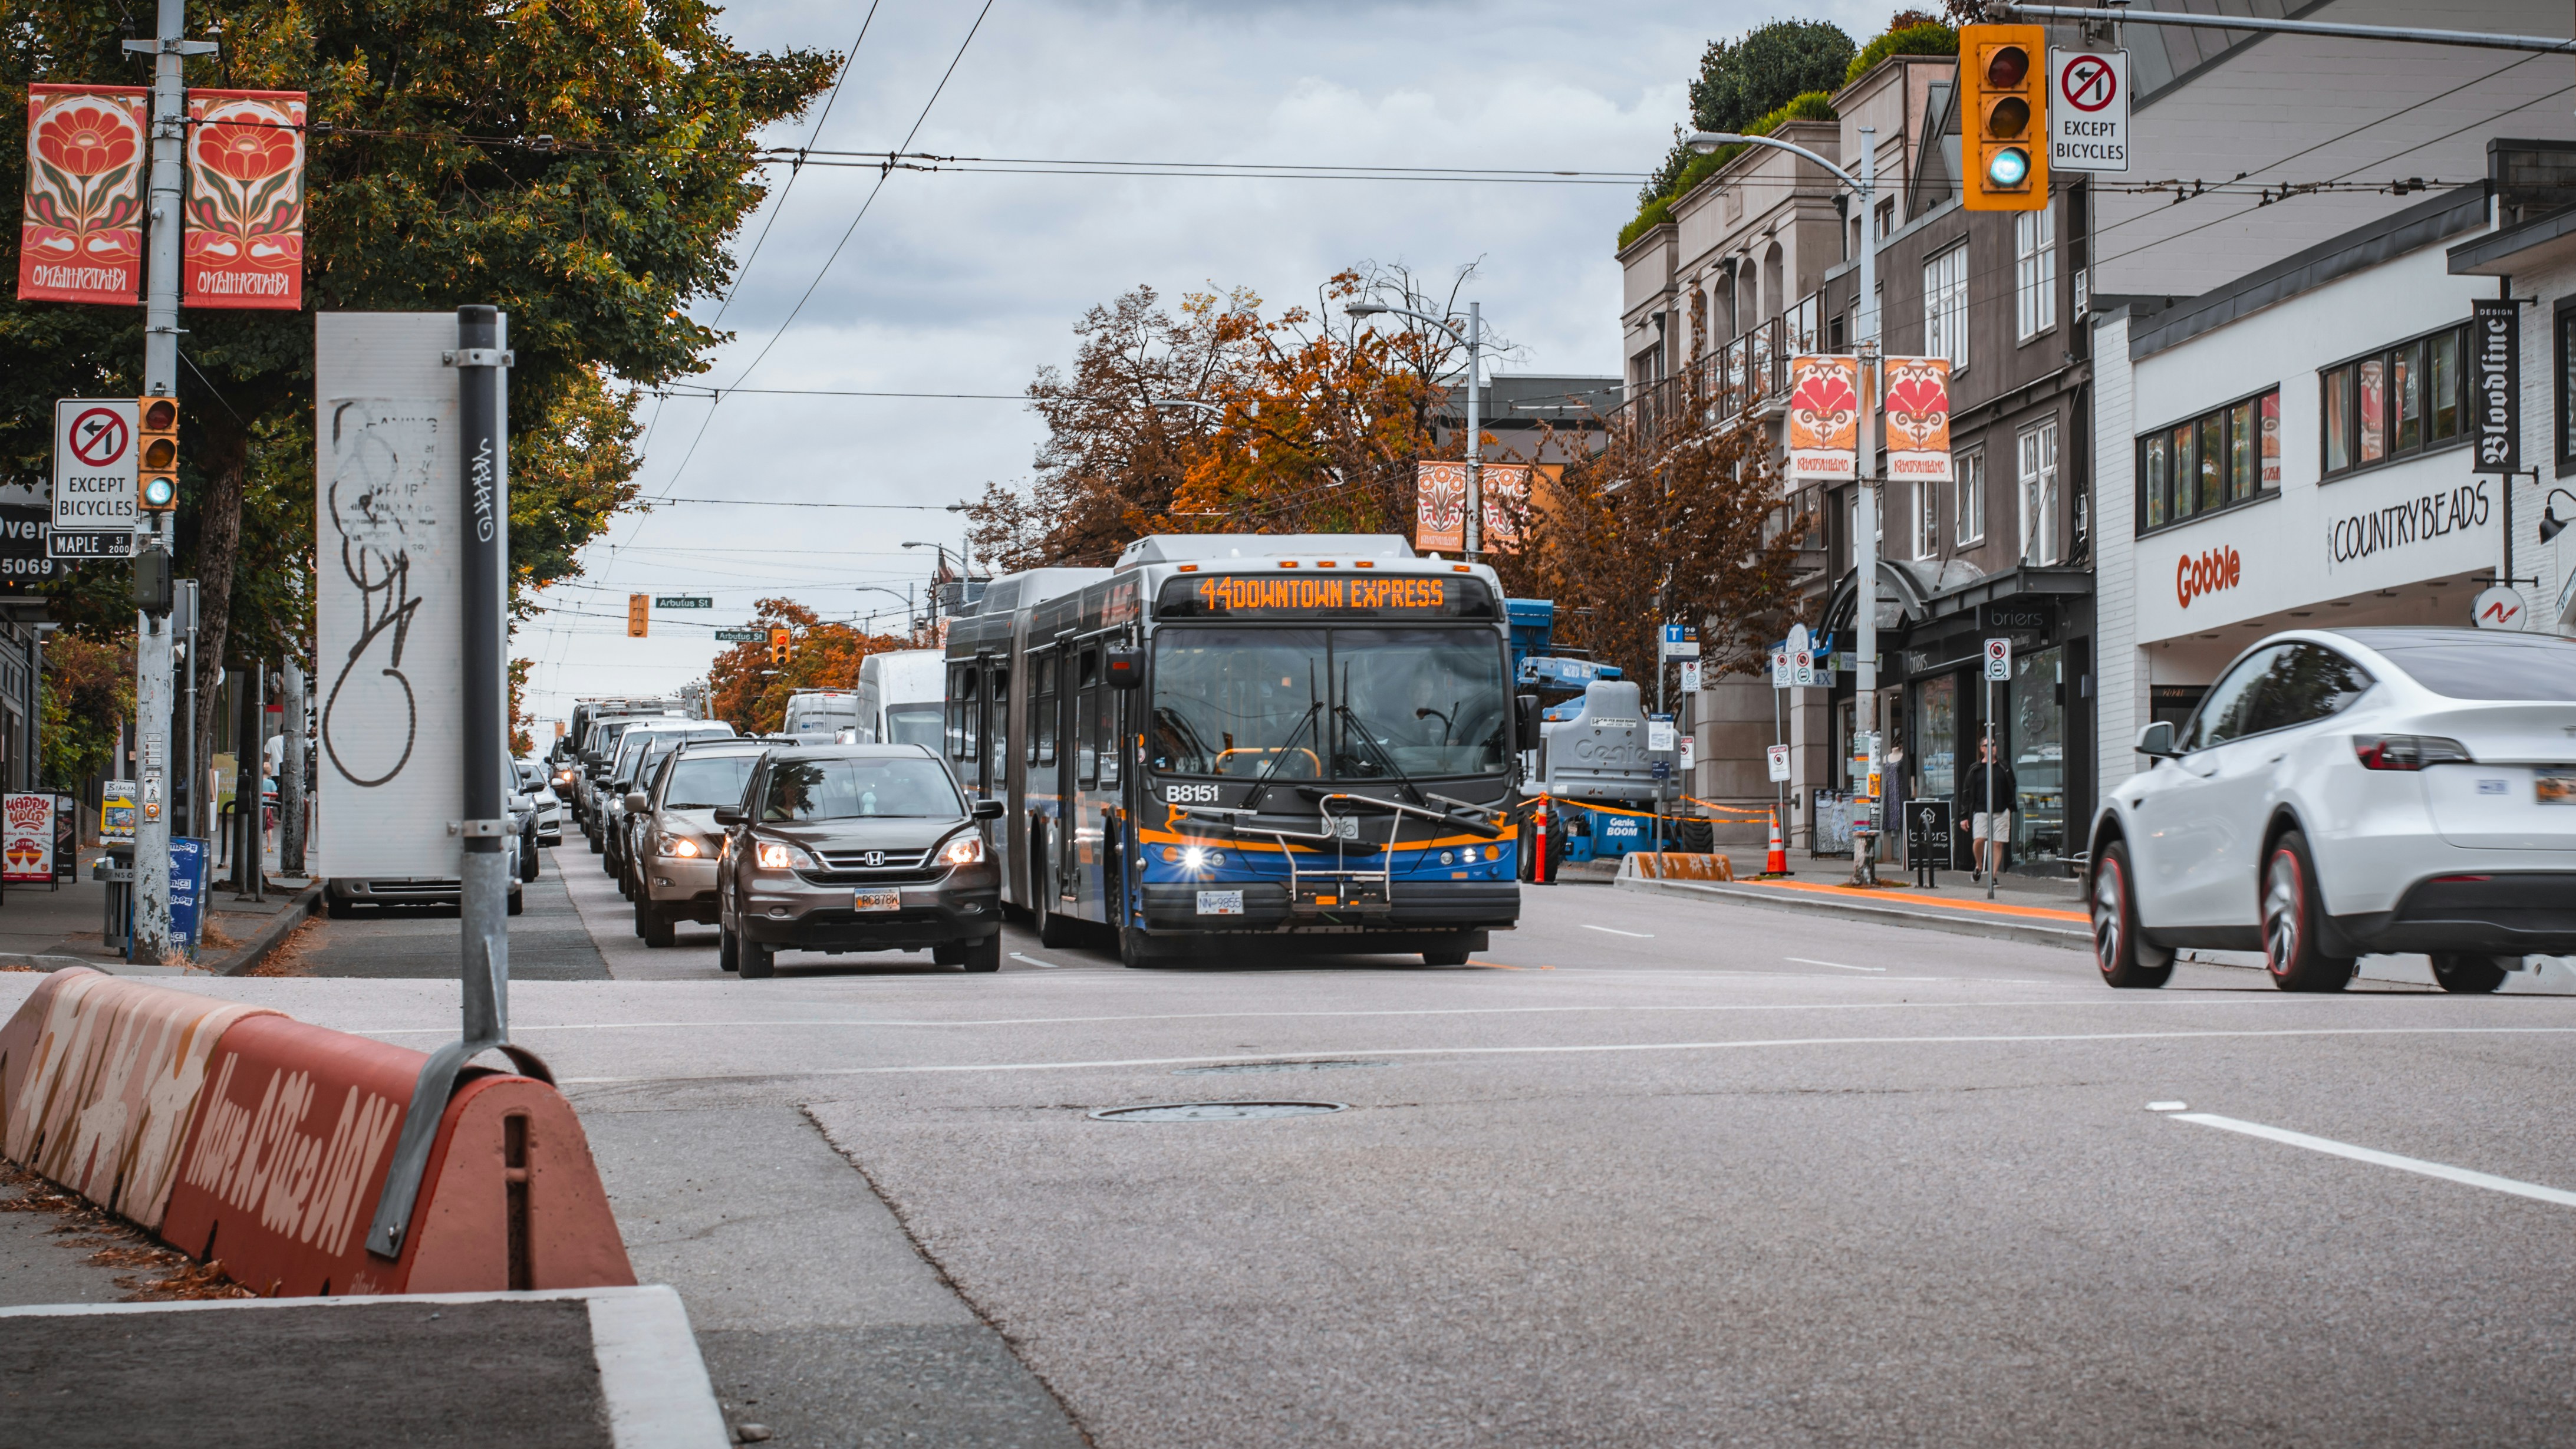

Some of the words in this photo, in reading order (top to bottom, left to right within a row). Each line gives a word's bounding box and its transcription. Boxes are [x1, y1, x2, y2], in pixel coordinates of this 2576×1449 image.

[2064, 121, 2116, 137] EXCEPT
[2056, 143, 2123, 160] BICYCLES
[2482, 318, 2509, 464] Bloodline
[69, 477, 126, 492] EXCEPT
[60, 500, 133, 516] BICYCLES
[57, 536, 99, 552] MAPLE
[1, 559, 52, 574] 5069
[2177, 545, 2240, 608] Gobble
[1200, 577, 1232, 610] 44
[1233, 580, 1343, 608] DOWNTOWN
[1350, 579, 1443, 608] EXPRESS
[660, 598, 694, 607] Arbutus
[699, 599, 708, 607] St
[1992, 608, 2043, 625] briers
[1669, 628, 1679, 640] T
[1575, 739, 1649, 764] Genie
[1167, 785, 1218, 802] B8151
[6, 796, 50, 812] HAPPY
[9, 809, 45, 825] HOUR
[1609, 818, 1635, 826] Genie
[1606, 827, 1638, 836] BOOM
[185, 1052, 251, 1201] Have
[246, 1070, 322, 1239] Nice
[301, 1085, 400, 1257] DAY
